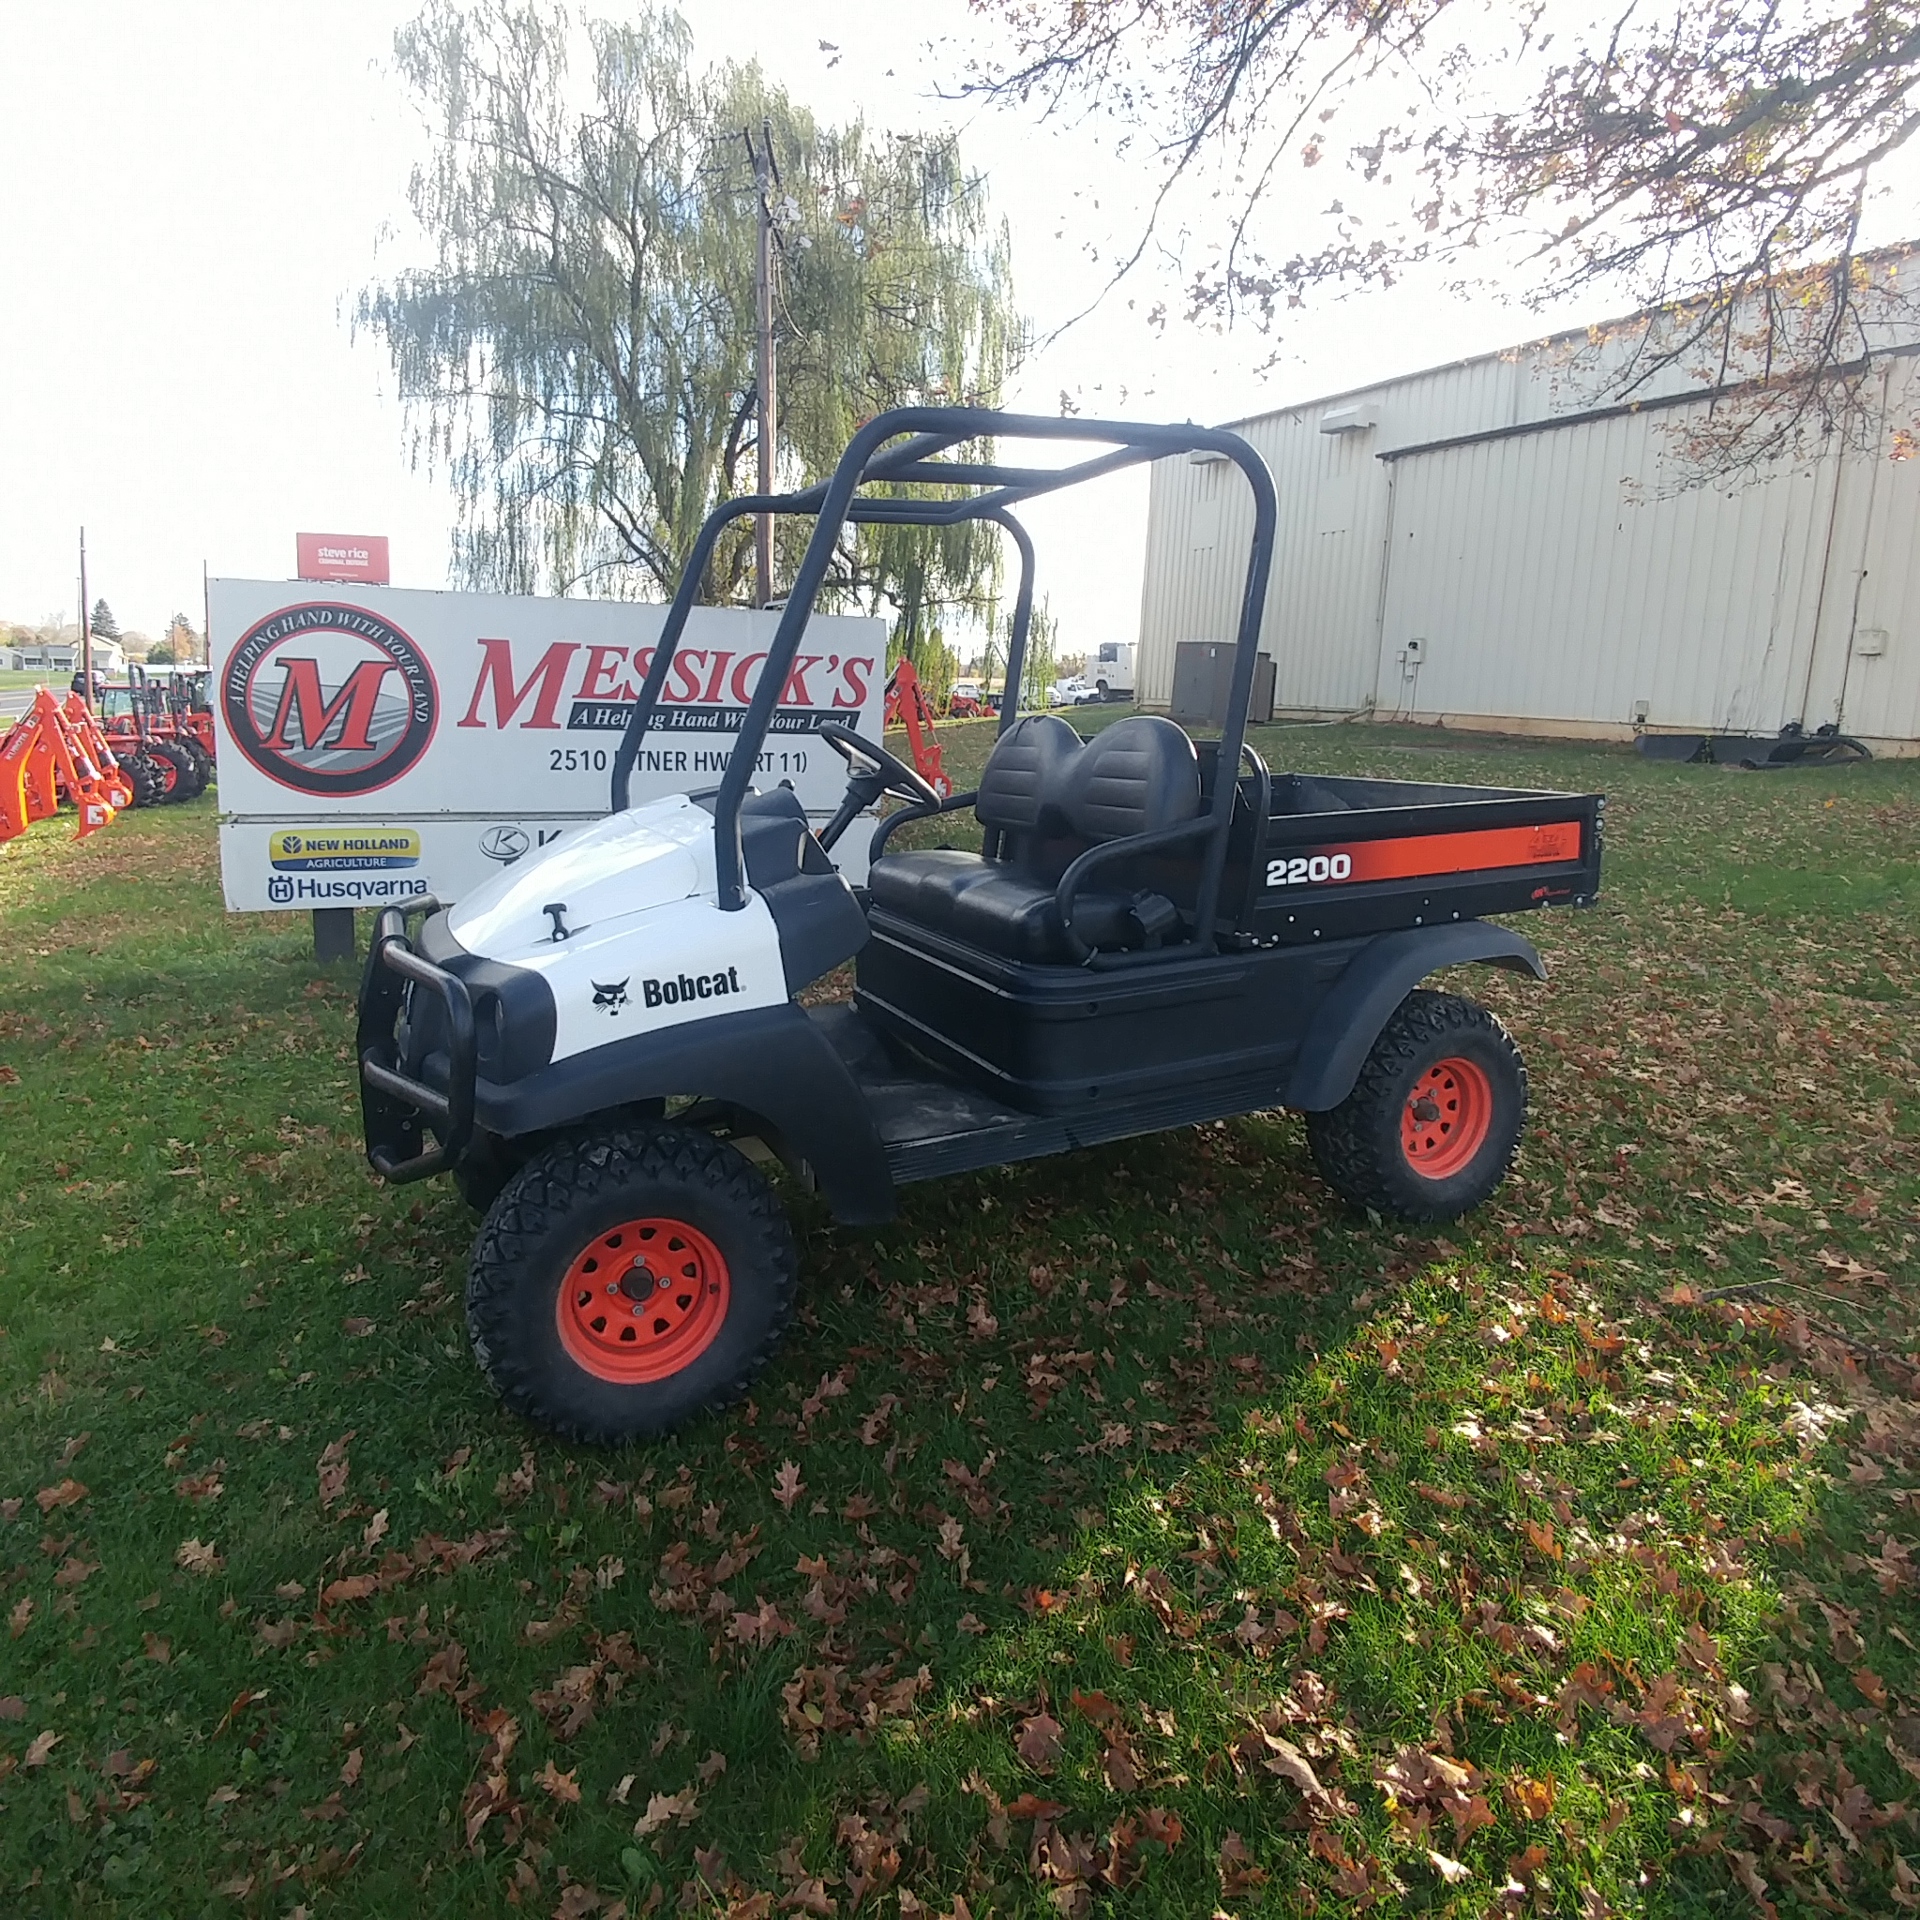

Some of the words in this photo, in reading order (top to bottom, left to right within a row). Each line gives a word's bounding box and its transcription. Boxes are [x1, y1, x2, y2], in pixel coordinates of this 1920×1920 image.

[318, 547, 346, 558] steve
[348, 547, 368, 559] rice
[281, 610, 333, 633] HAND
[337, 612, 385, 640] WITH
[230, 624, 280, 694] HELPING
[384, 635, 419, 677] YOUR
[457, 638, 875, 729] MESSICK'S
[229, 694, 245, 708] A
[410, 679, 430, 723] LAND
[573, 708, 589, 725] A
[593, 708, 666, 730] Helg
[669, 710, 720, 728] Hand
[769, 714, 805, 730] Your
[550, 750, 606, 771] 2510
[614, 751, 687, 772] TNER
[695, 751, 735, 772] HW
[780, 752, 807, 774] 11)
[306, 839, 339, 851] NEW
[343, 838, 410, 850] HOLLAND
[306, 857, 387, 868] AGRICULTURE
[1266, 853, 1351, 887] 2200
[297, 878, 427, 900] Husqvarna
[642, 966, 740, 1009] Bobcat
